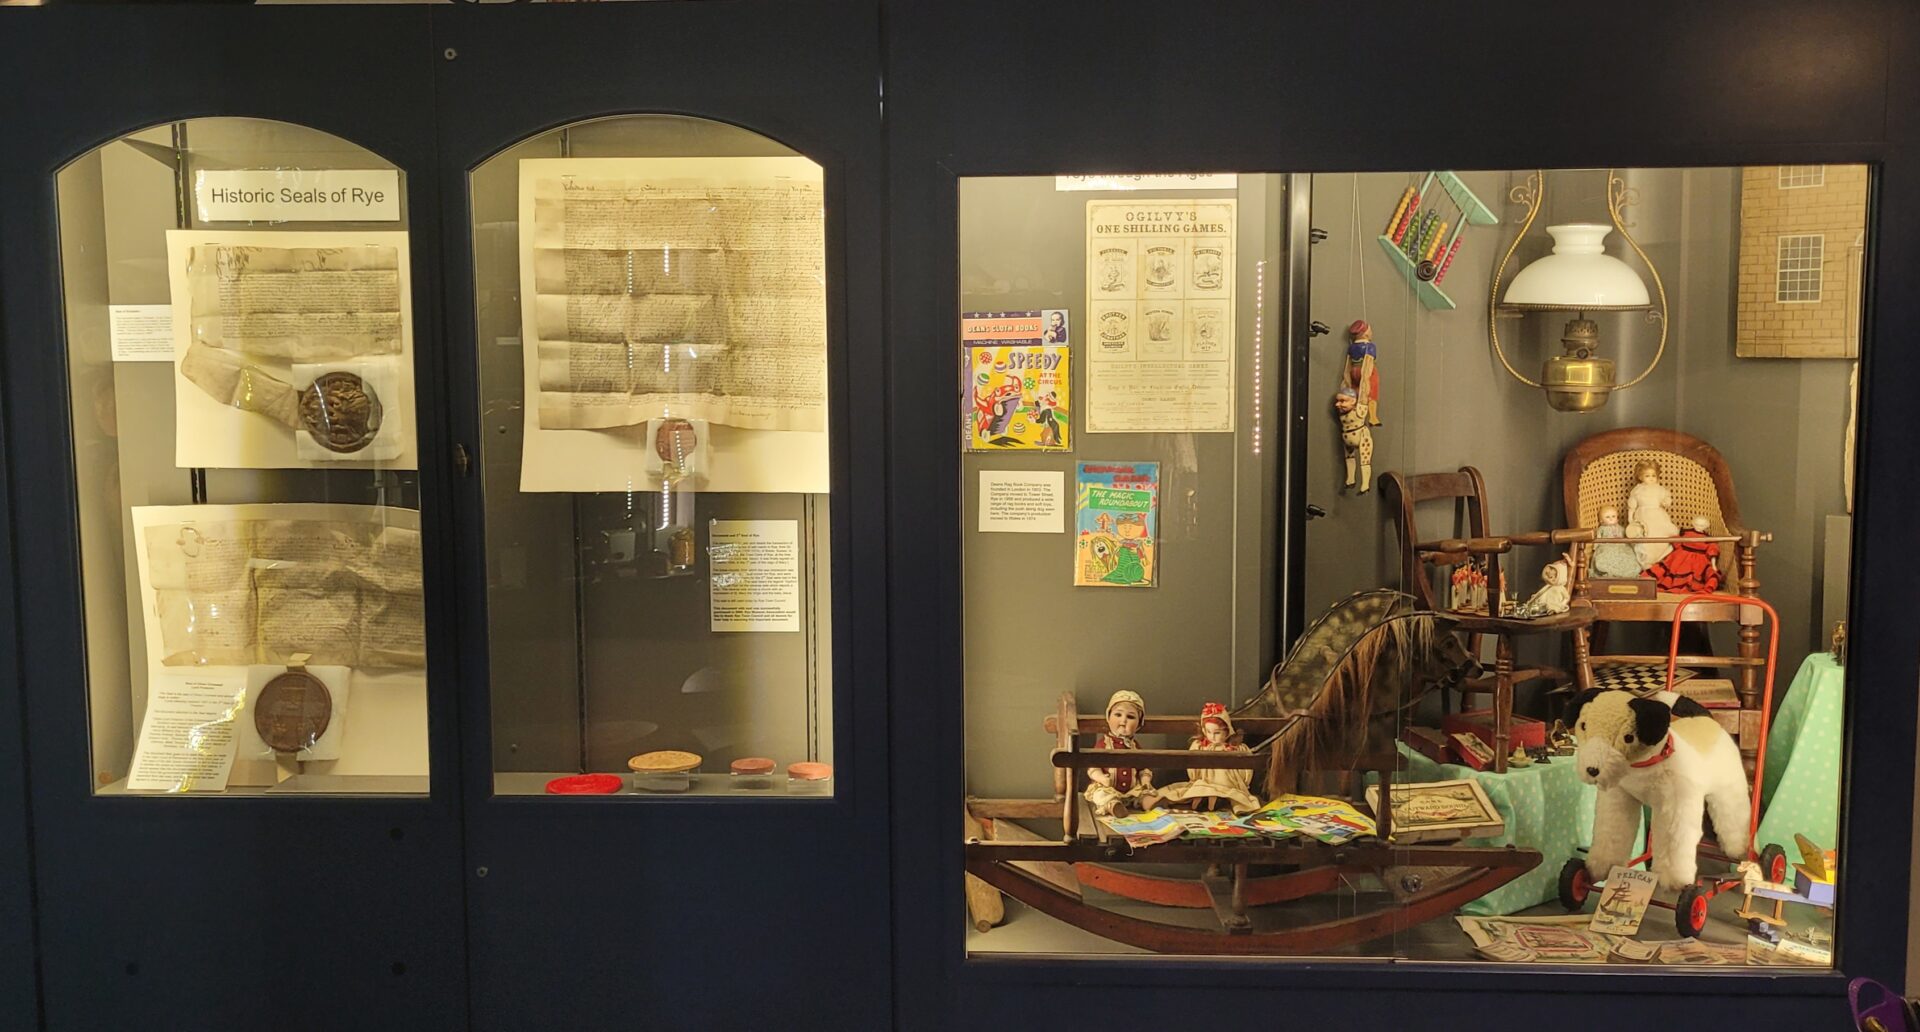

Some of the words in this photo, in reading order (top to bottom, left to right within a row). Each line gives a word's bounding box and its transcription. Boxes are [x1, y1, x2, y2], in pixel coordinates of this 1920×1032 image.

[212, 188, 274, 203] Historic
[281, 188, 326, 203] Seals
[331, 188, 346, 203] of
[352, 188, 384, 208] Rye
[1126, 212, 1197, 221] OGILVY'S
[1097, 225, 1120, 233] ONE
[1124, 224, 1180, 232] SHILLING
[1184, 224, 1226, 232] GAMES.
[968, 324, 990, 333] DEANS
[992, 324, 1012, 332] CLOTH
[1008, 352, 1062, 370] SPEEDY
[1099, 498, 1150, 508] ROUNDABOUT
[1617, 872, 1653, 885] PELICAN
